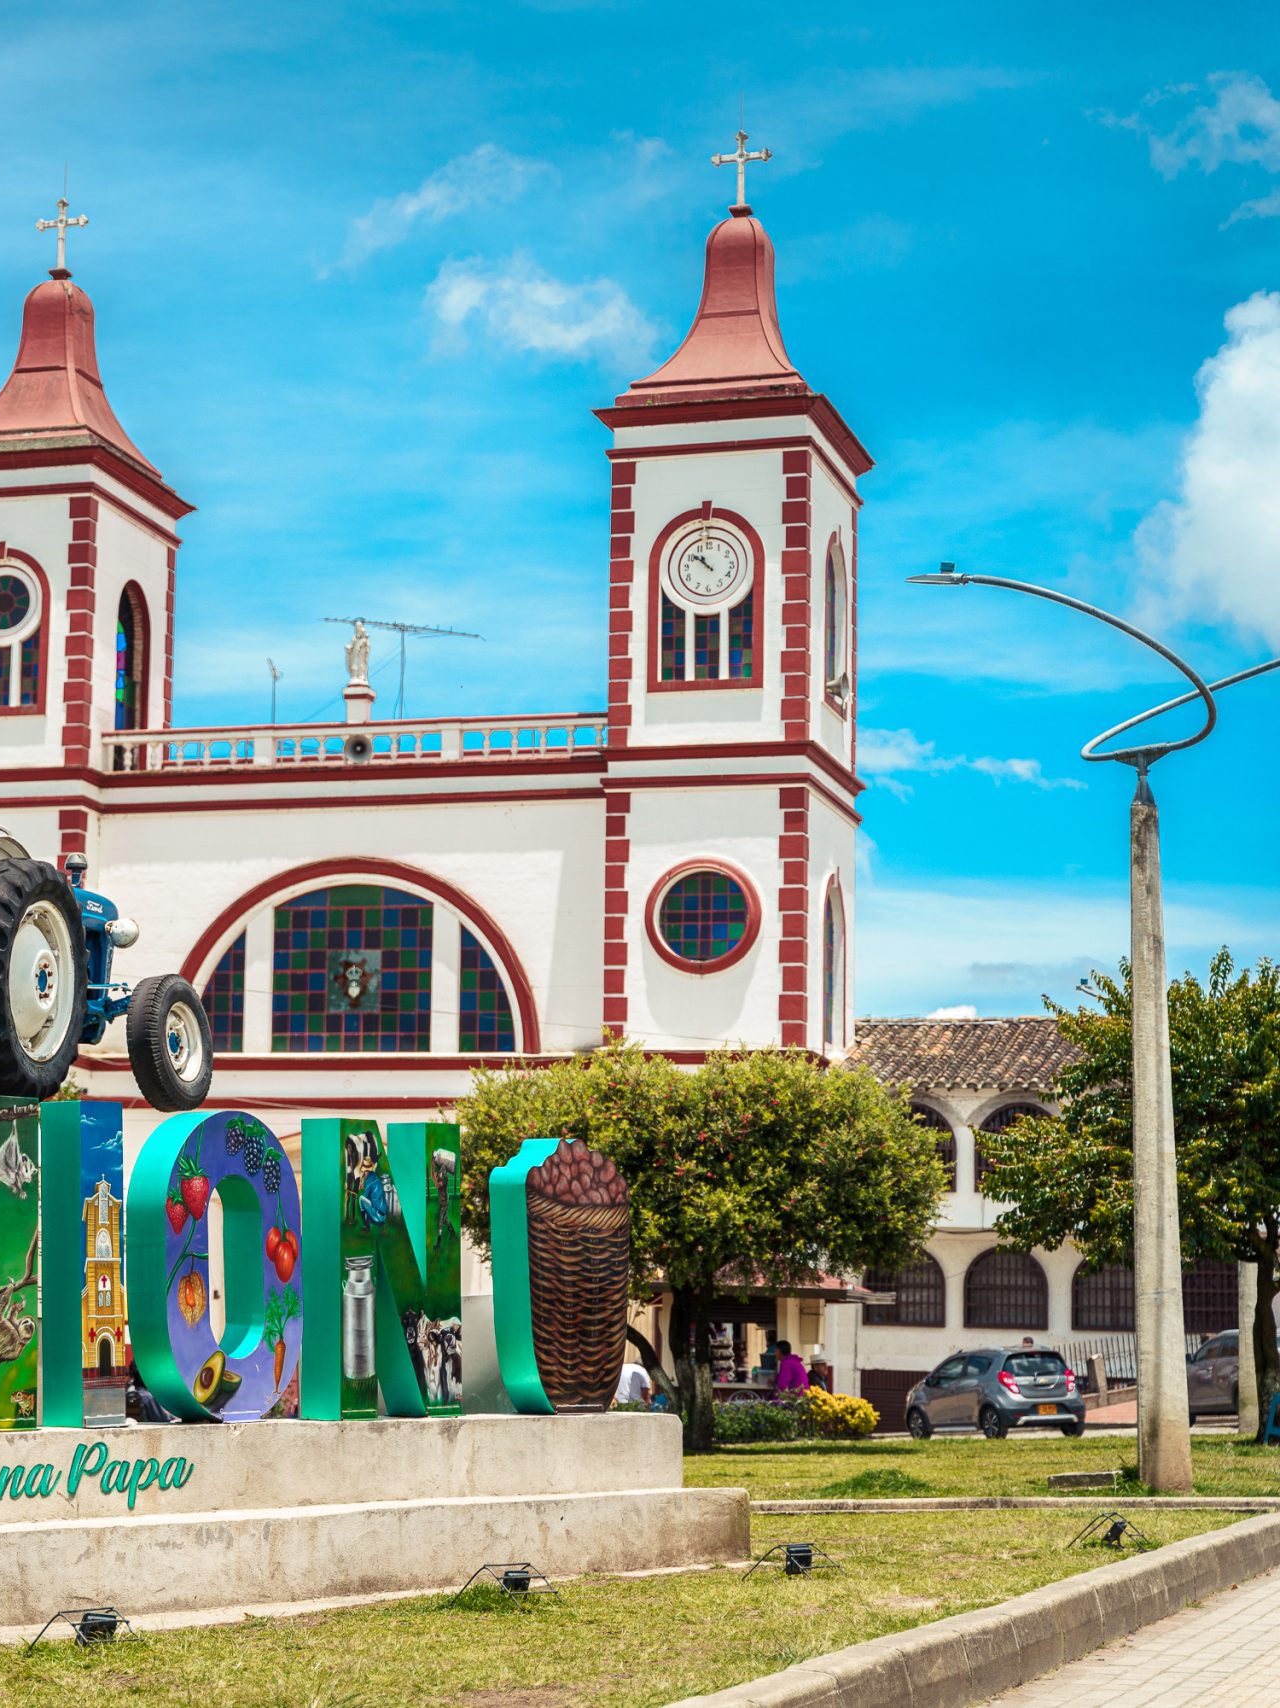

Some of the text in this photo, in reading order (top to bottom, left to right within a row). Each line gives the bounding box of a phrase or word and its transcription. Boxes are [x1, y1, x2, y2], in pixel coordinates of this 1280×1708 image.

[697, 545, 703, 553] 11
[706, 541, 713, 550] 12
[724, 550, 730, 558] 2
[729, 561, 735, 569] 3
[686, 573, 691, 581] 8
[725, 570, 731, 578] 4
[717, 578, 723, 587] 5
[706, 584, 711, 592] 6
[86, 900, 103, 914] Ford
[66, 1441, 194, 1511] Papa
